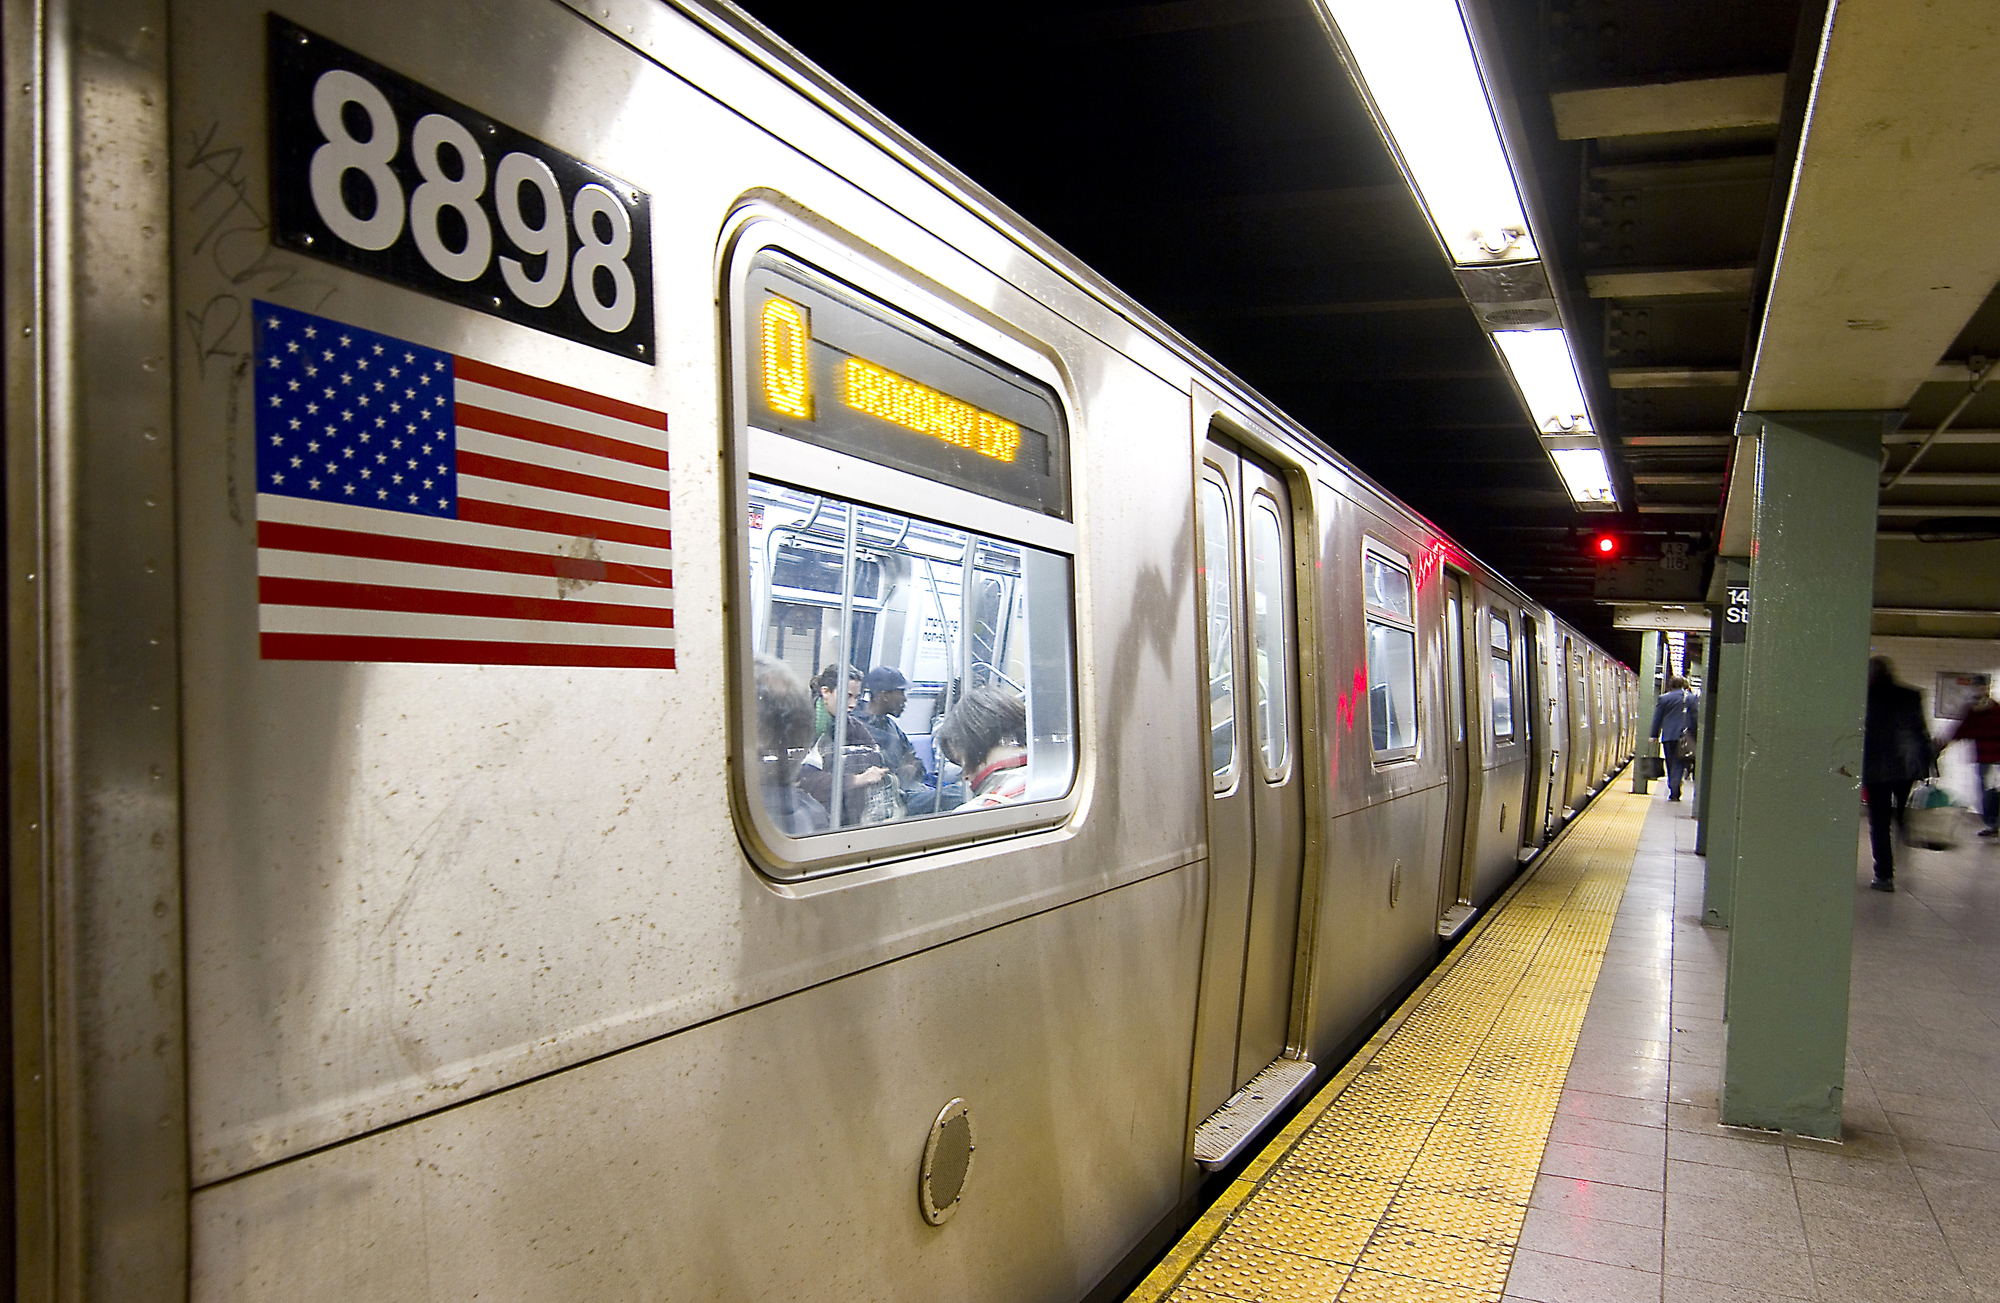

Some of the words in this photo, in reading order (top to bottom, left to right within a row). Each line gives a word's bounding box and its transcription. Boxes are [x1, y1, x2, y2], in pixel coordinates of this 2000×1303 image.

[310, 69, 636, 332] 8898
[763, 297, 809, 418] Q
[846, 357, 972, 450] BROADWAY
[1726, 607, 1749, 623] St
[1728, 590, 1749, 605] 14
